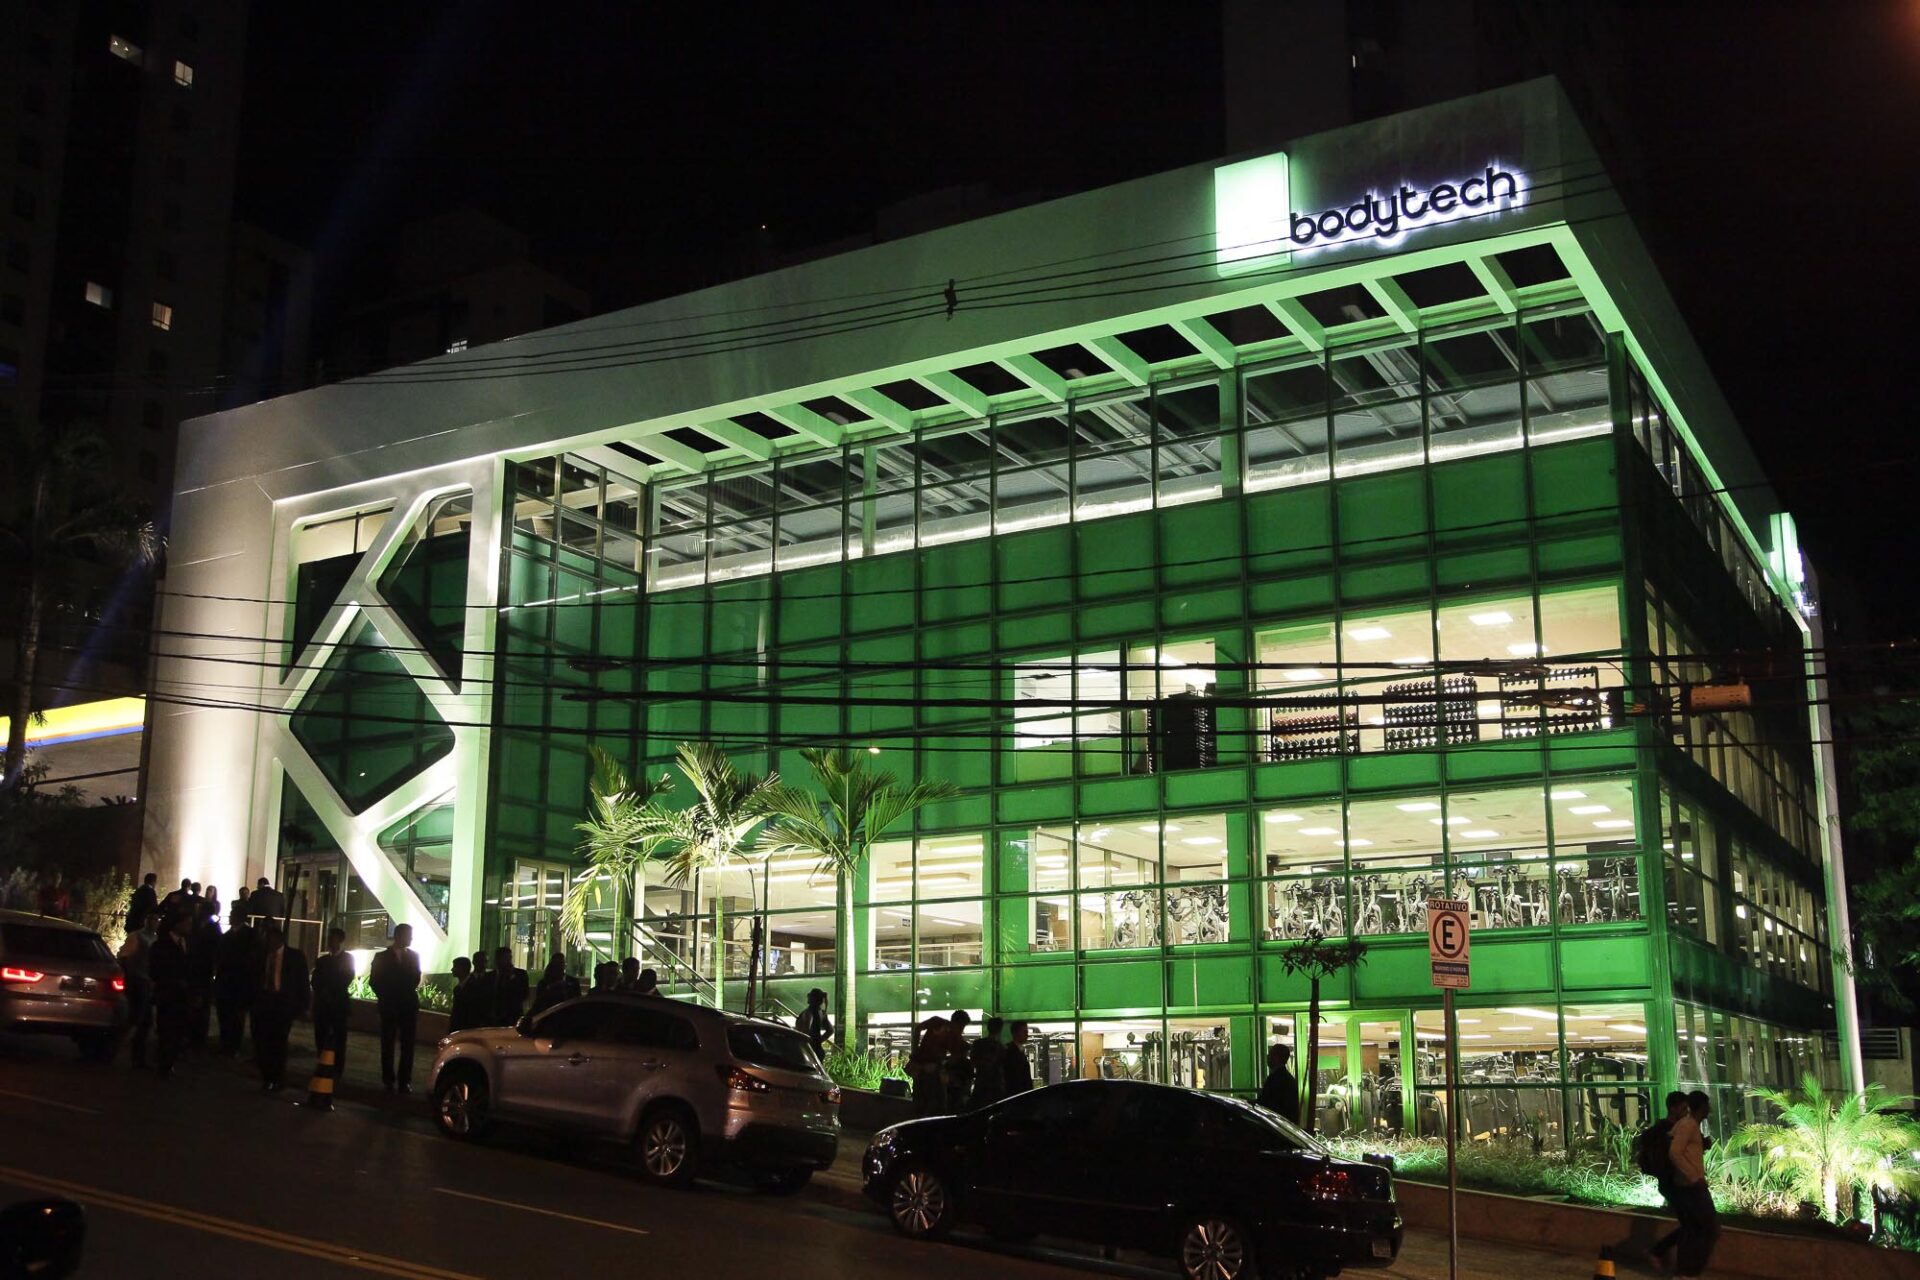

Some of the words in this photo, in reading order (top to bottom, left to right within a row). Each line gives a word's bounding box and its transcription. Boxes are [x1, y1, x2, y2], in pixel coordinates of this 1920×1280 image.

[1290, 167, 1516, 244] bodytech
[1429, 900, 1468, 911] ROTATIVO
[1442, 920, 1455, 950] E
